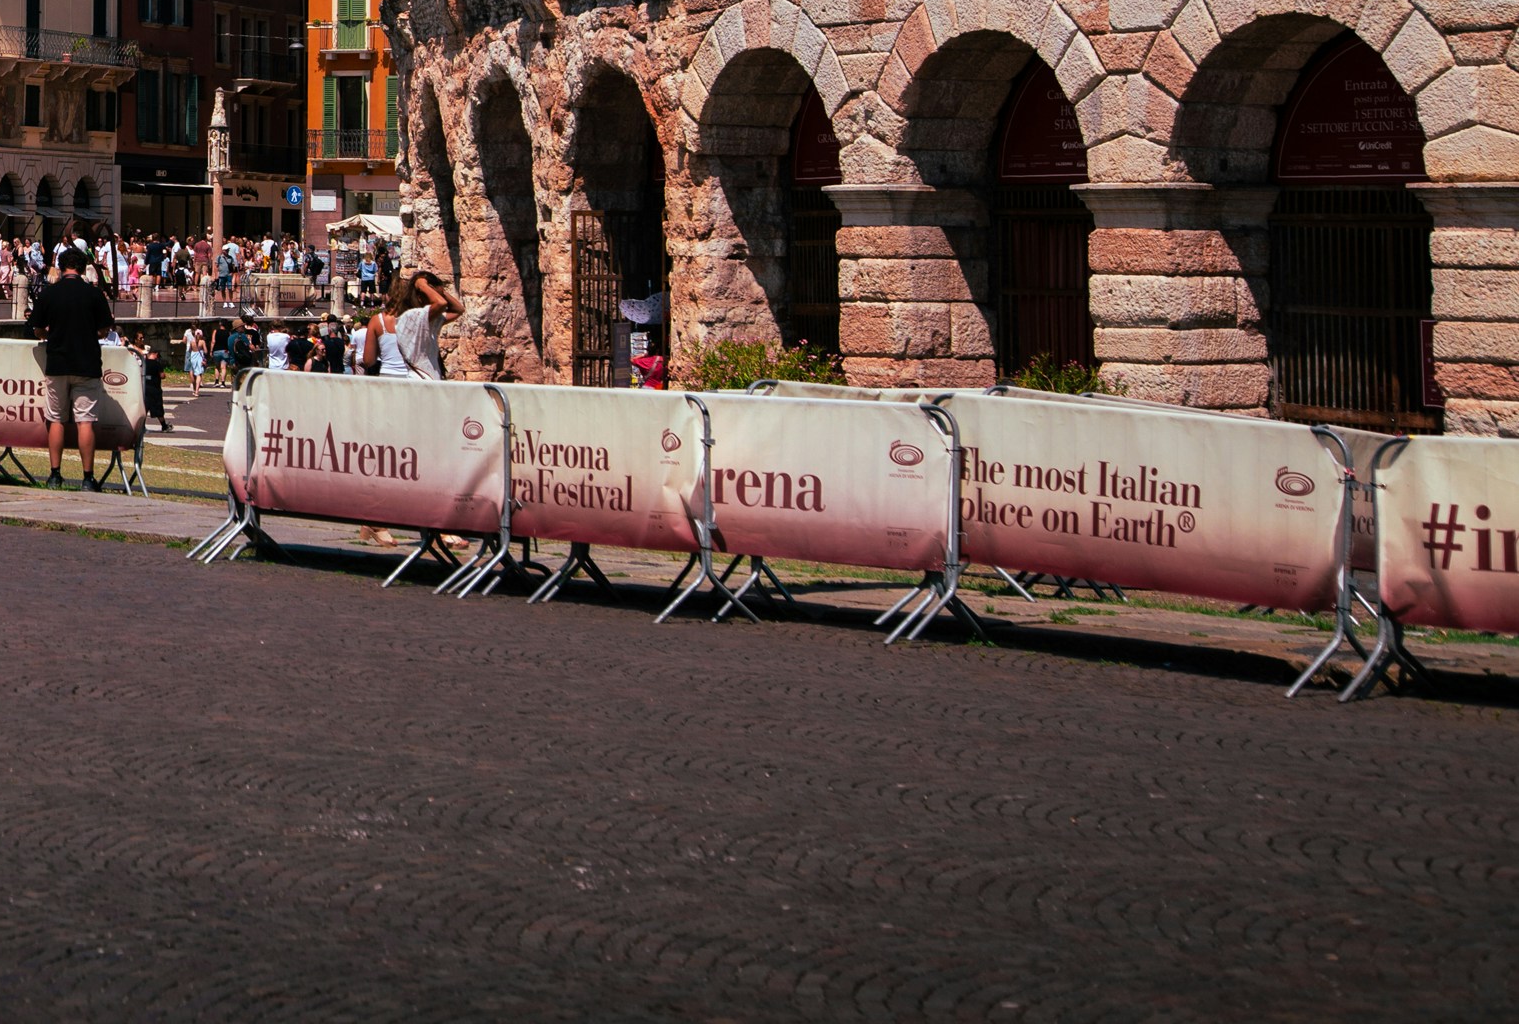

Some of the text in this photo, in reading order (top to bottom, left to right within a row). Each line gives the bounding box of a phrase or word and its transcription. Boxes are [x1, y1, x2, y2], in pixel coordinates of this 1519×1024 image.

[1344, 79, 1388, 91] Entrata
[1307, 122, 1350, 133] SETTORE
[1352, 121, 1394, 132] PUCCINI
[1361, 108, 1405, 119] SETTORE
[280, 291, 296, 300] rena
[261, 419, 421, 481] #inArena
[523, 429, 611, 471] Verona
[536, 468, 634, 512] Festival
[712, 468, 826, 512] rena
[1012, 461, 1087, 495] most
[1098, 460, 1202, 509] Italian
[1042, 507, 1081, 535] on
